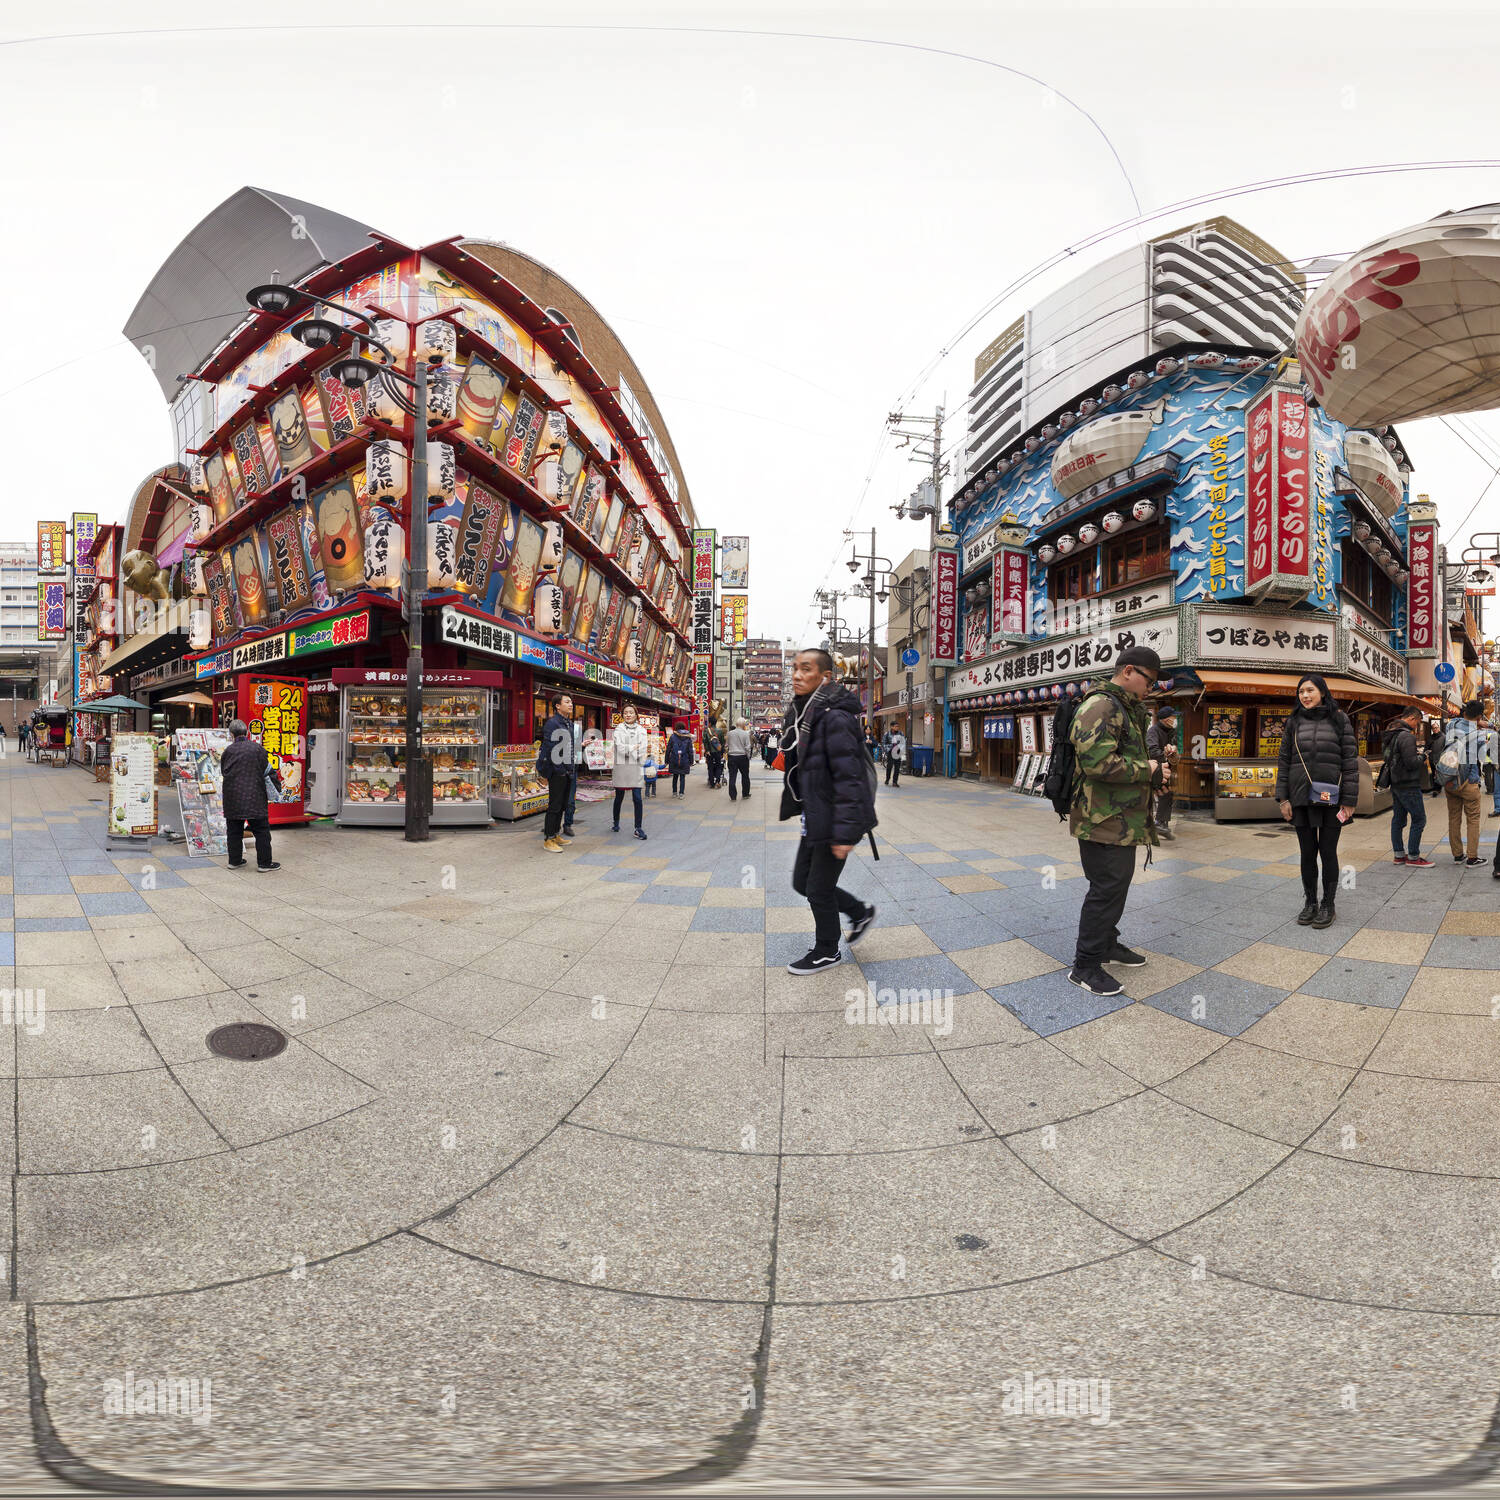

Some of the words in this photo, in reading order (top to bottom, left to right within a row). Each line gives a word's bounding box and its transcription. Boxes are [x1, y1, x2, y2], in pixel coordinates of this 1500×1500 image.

[1207, 435, 1230, 592] 安うて何んでも旨い
[1281, 468, 1306, 564] てっちり
[46, 584, 64, 630] 横綱
[1114, 593, 1160, 614] 日本一
[1412, 547, 1430, 645] 珍味てっちり
[332, 613, 369, 646] 横綱
[445, 615, 513, 655] 24時間営業
[695, 598, 712, 644] 通天閣
[1205, 626, 1329, 652] づぼらや本店
[235, 638, 284, 667] 24時間営業
[1350, 637, 1405, 688] ふぐ料理専門
[279, 689, 302, 755] 24時間
